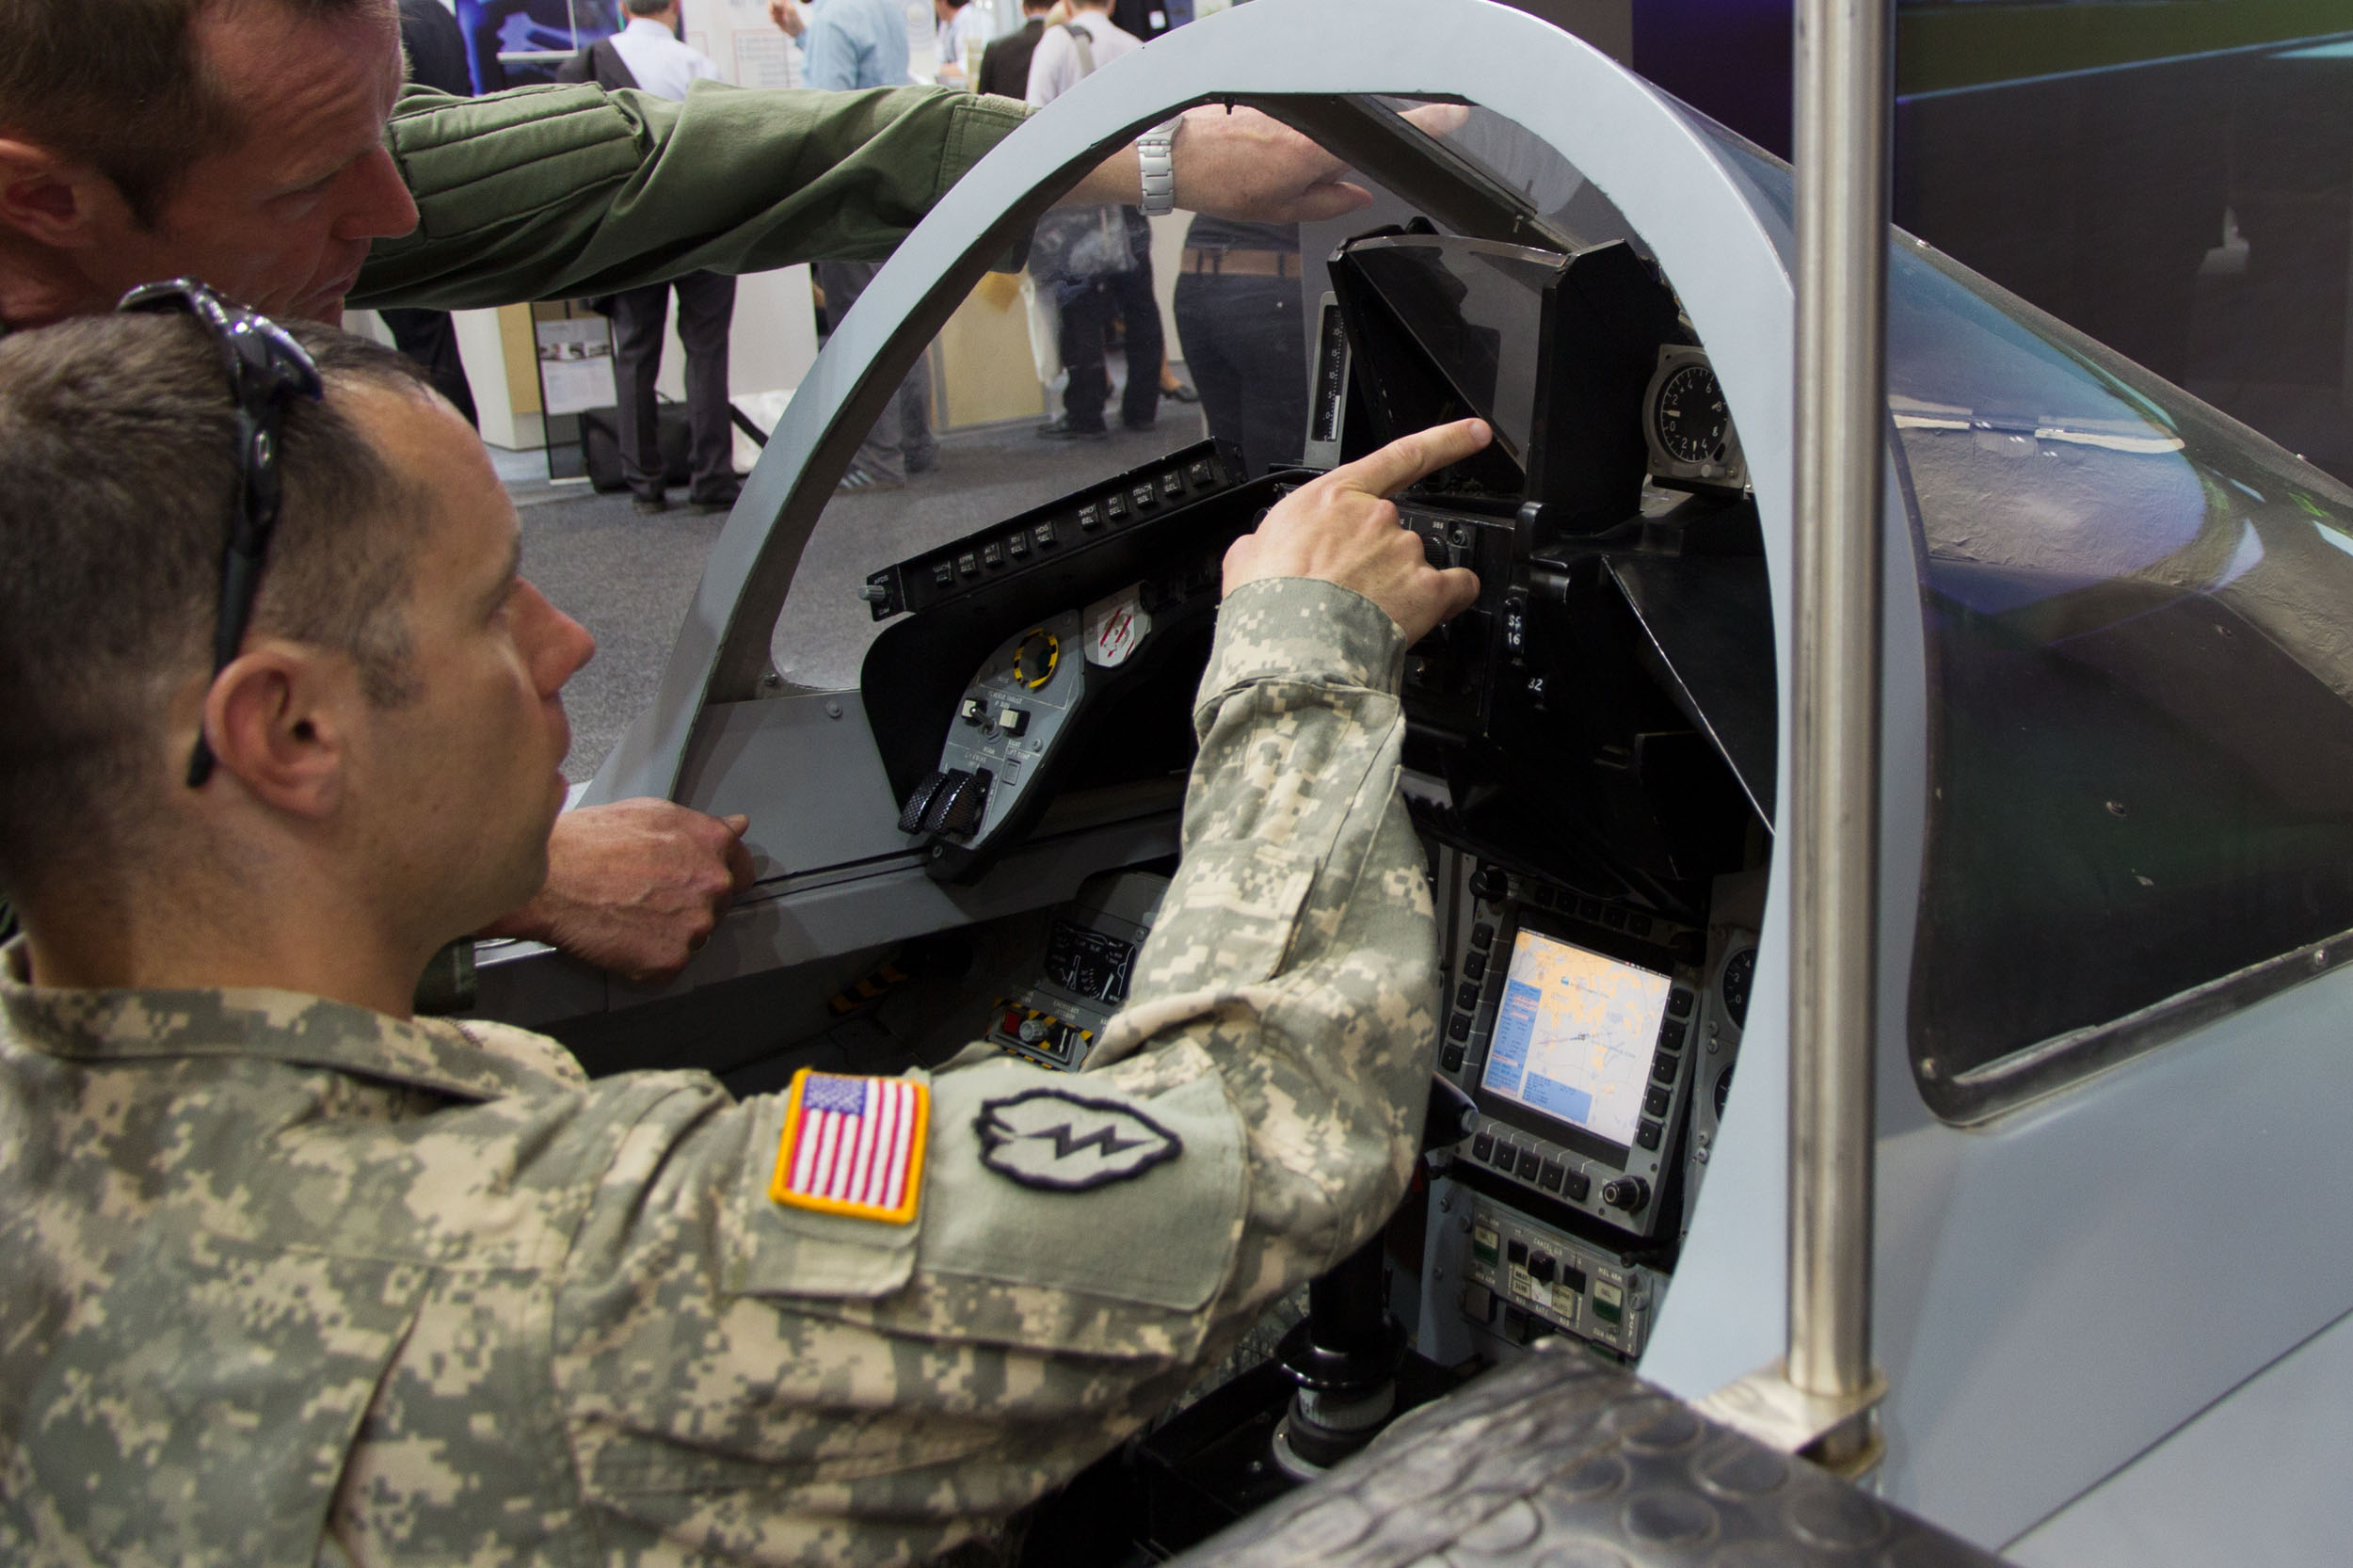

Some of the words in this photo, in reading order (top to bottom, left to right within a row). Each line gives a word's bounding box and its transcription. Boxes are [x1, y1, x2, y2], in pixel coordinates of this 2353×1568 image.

[1705, 382, 1712, 393] 6
[1673, 394, 1678, 405] 2
[1670, 421, 1675, 432] 0
[1681, 437, 1688, 449] 2
[1701, 438, 1707, 449] 4
[1508, 632, 1521, 646] 16
[1528, 678, 1544, 692] 32
